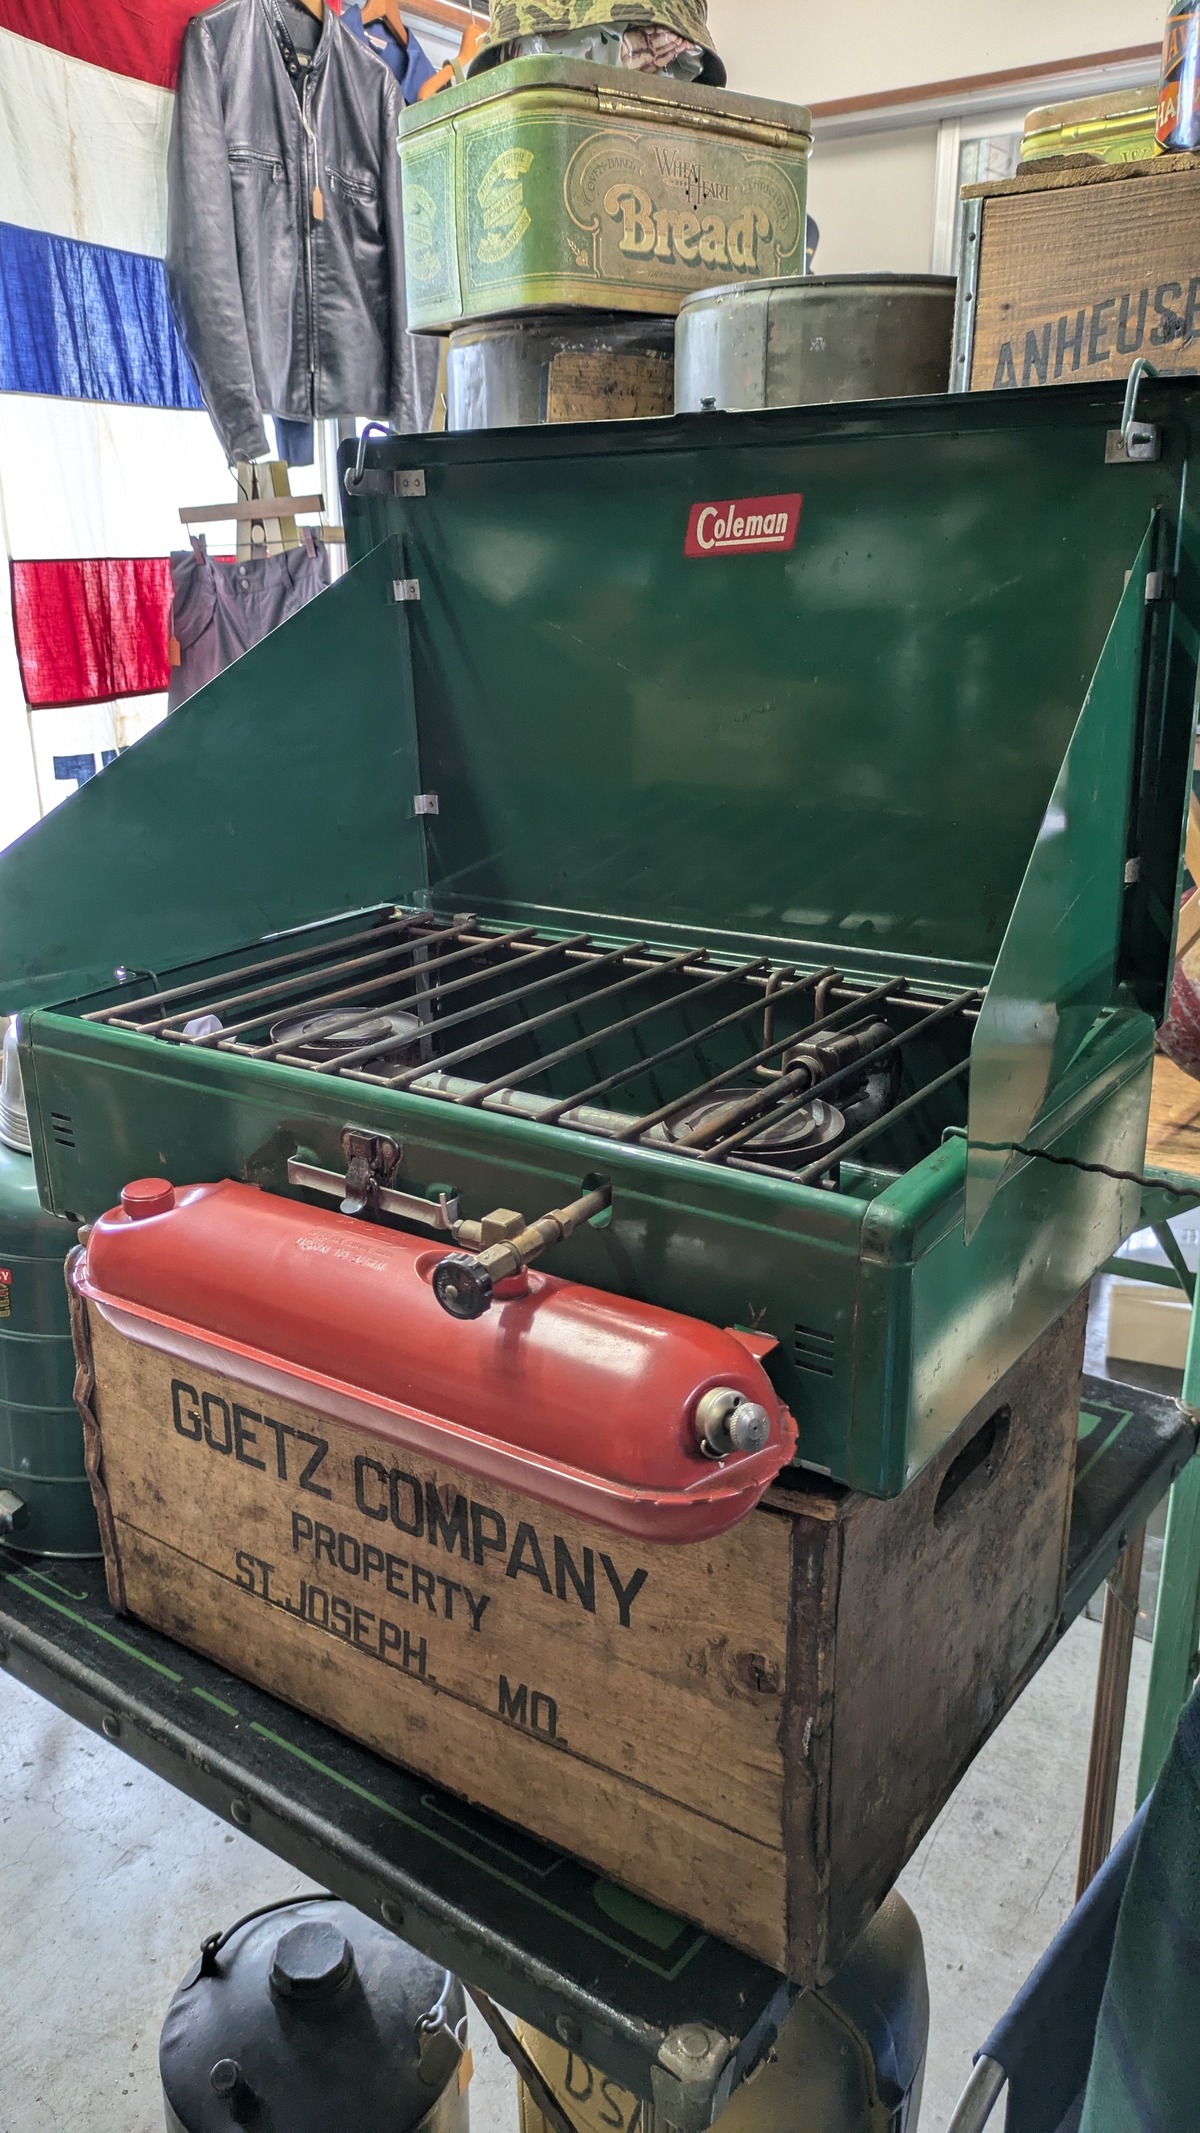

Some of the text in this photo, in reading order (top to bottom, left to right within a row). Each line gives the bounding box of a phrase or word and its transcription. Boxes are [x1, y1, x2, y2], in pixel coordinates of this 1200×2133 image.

[587, 157, 637, 192] OVEN-BAKED
[652, 145, 705, 178] WHEAT
[686, 172, 732, 204] HEART
[604, 183, 772, 270] Bread
[697, 504, 788, 549] Coleman
[171, 1378, 649, 1629] GOETZ COMPANY
[292, 1511, 491, 1633] PROPERTY
